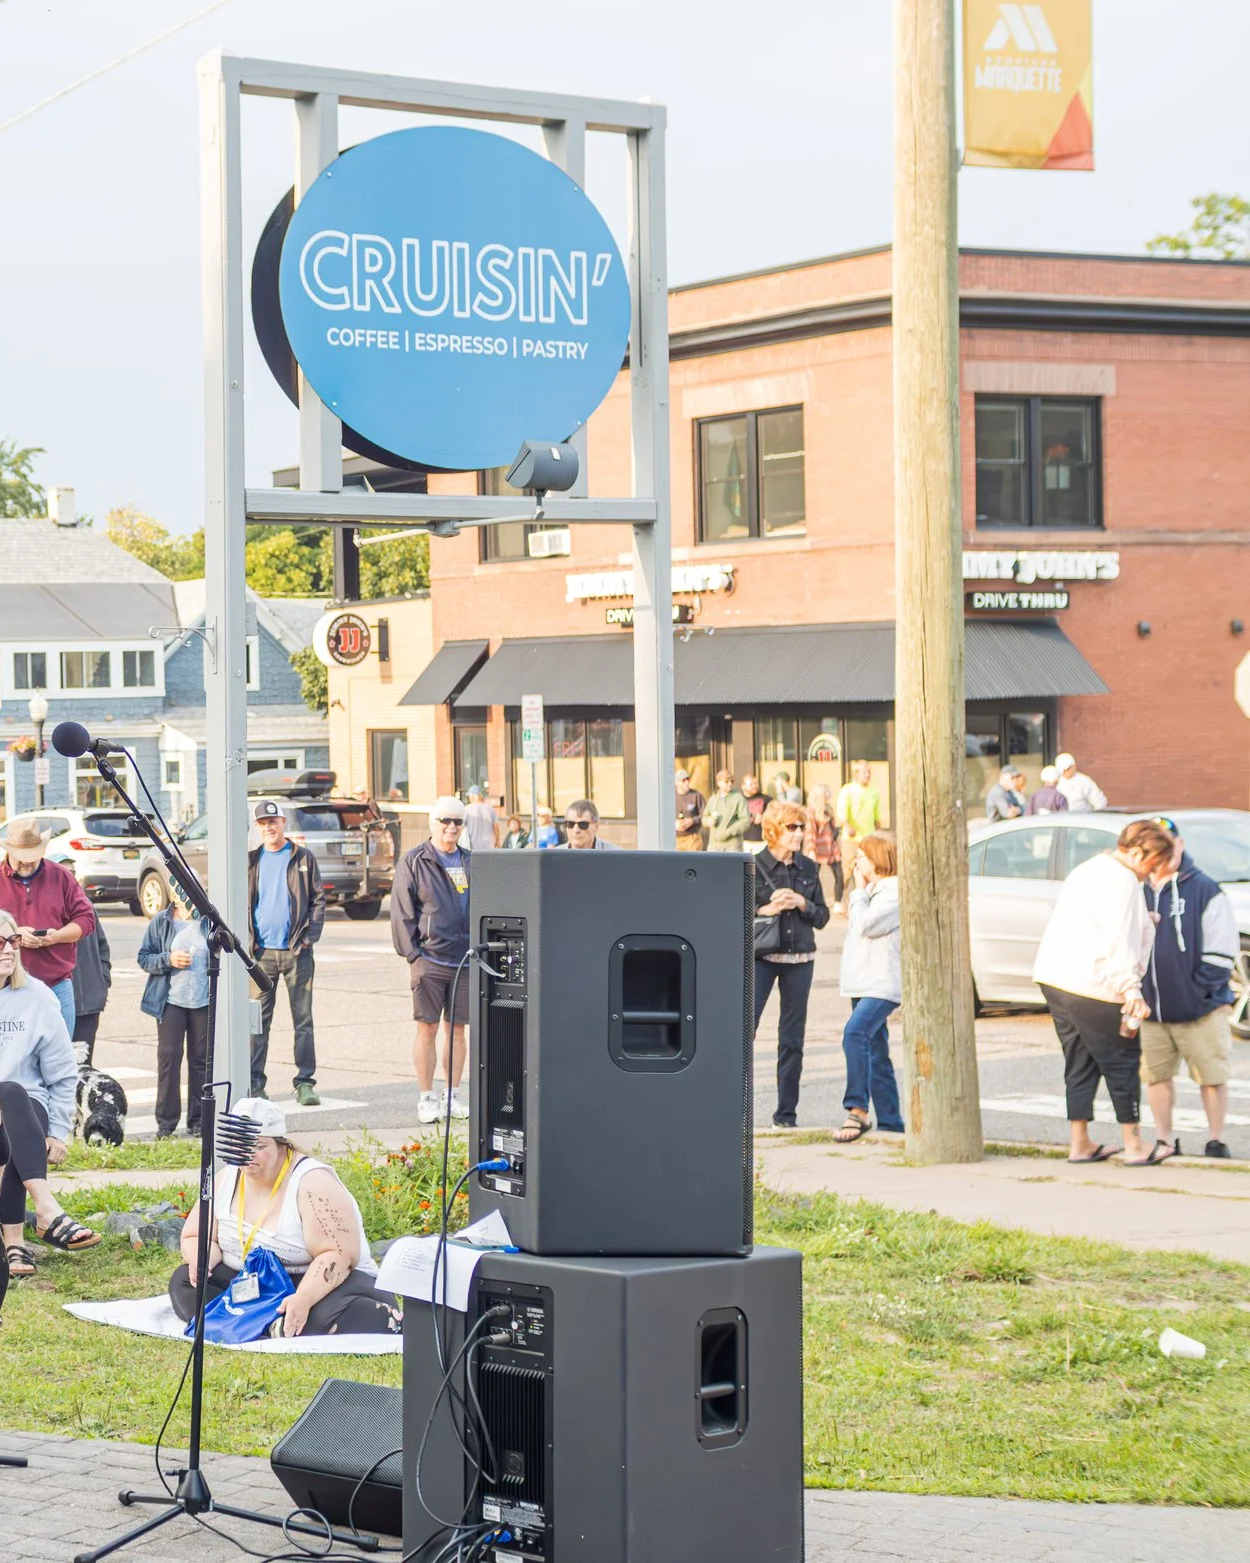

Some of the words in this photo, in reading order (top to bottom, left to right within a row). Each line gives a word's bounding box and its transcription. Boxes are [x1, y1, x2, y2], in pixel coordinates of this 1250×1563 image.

[974, 64, 1062, 94] MARQUETTE
[299, 229, 612, 326] CRUISIN'
[327, 327, 400, 350] COFFEE
[415, 332, 508, 356] ESPRESSO
[522, 340, 589, 361] PASTRY
[973, 592, 1018, 608] DRIVE
[1018, 592, 1069, 608] THRU
[606, 608, 634, 624] DRIV
[338, 627, 361, 653] JJ
